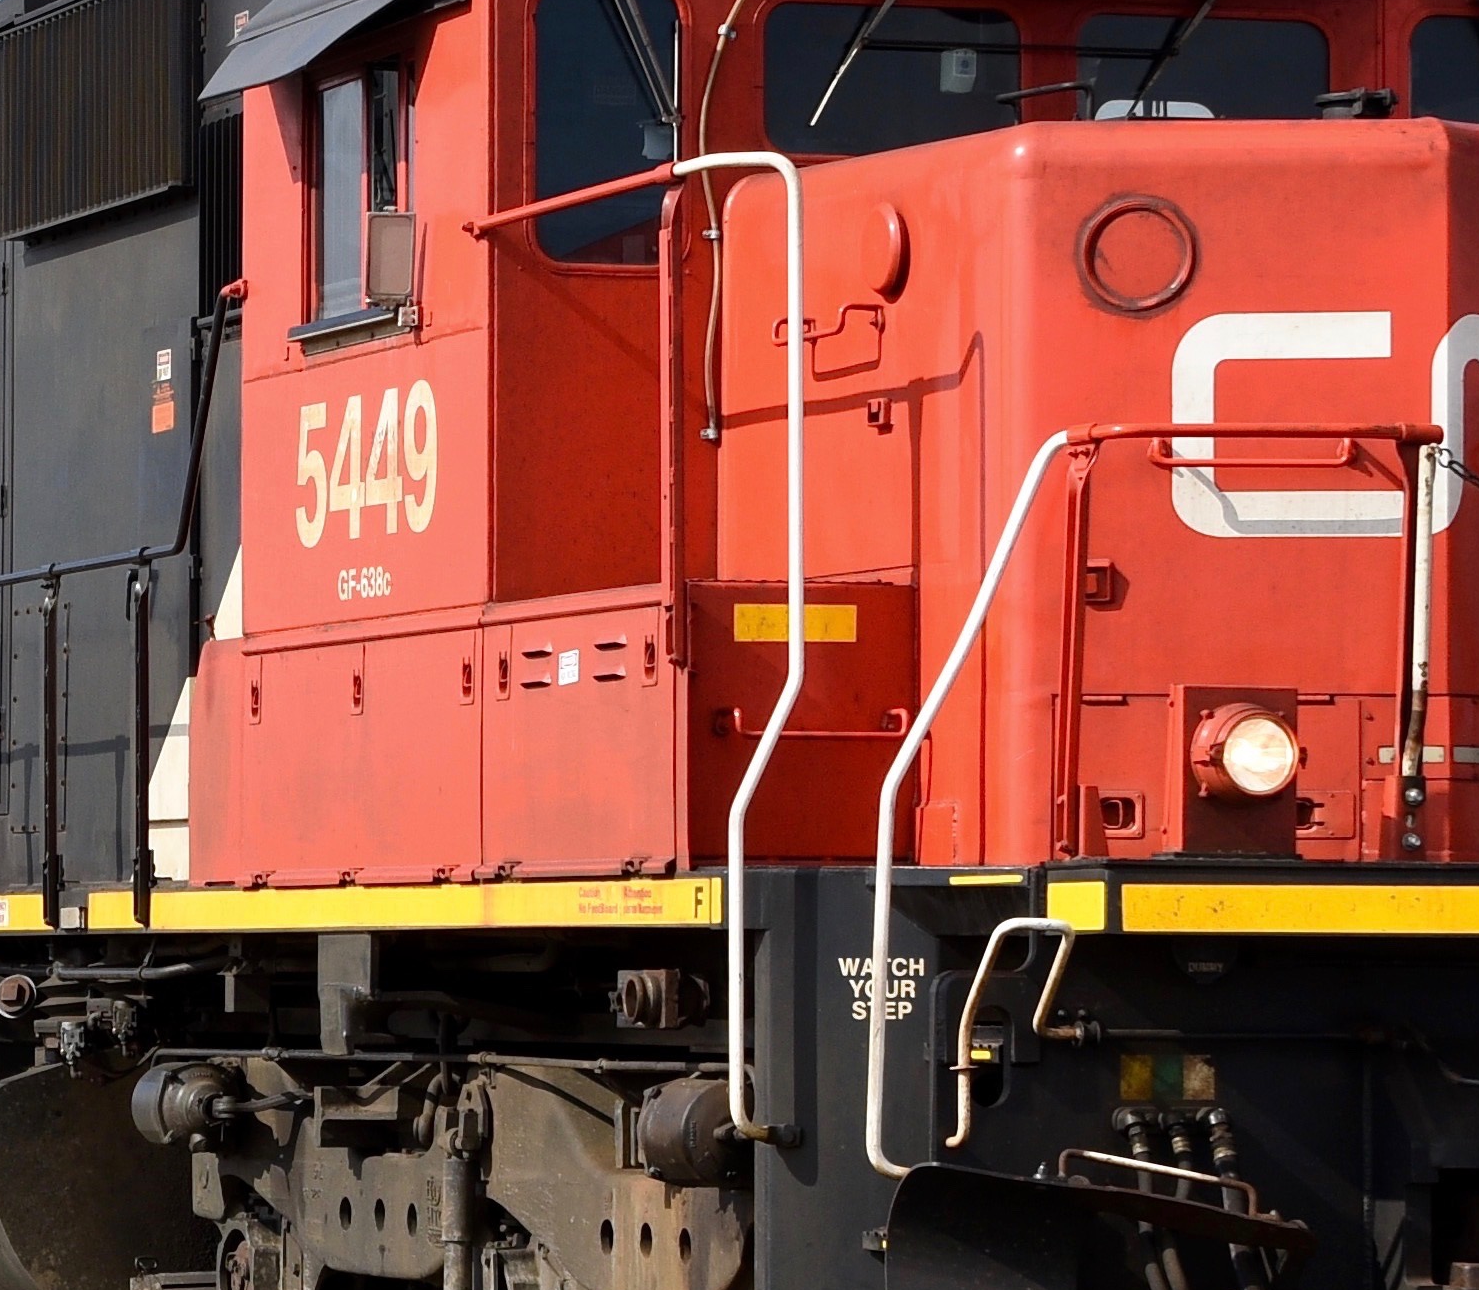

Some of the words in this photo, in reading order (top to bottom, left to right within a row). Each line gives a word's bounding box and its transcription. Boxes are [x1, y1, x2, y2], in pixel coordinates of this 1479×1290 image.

[295, 379, 438, 548] 5449
[337, 566, 392, 601] GF-638c
[694, 886, 704, 919] F
[837, 957, 925, 977] WACH
[851, 1000, 913, 1021] SEP
